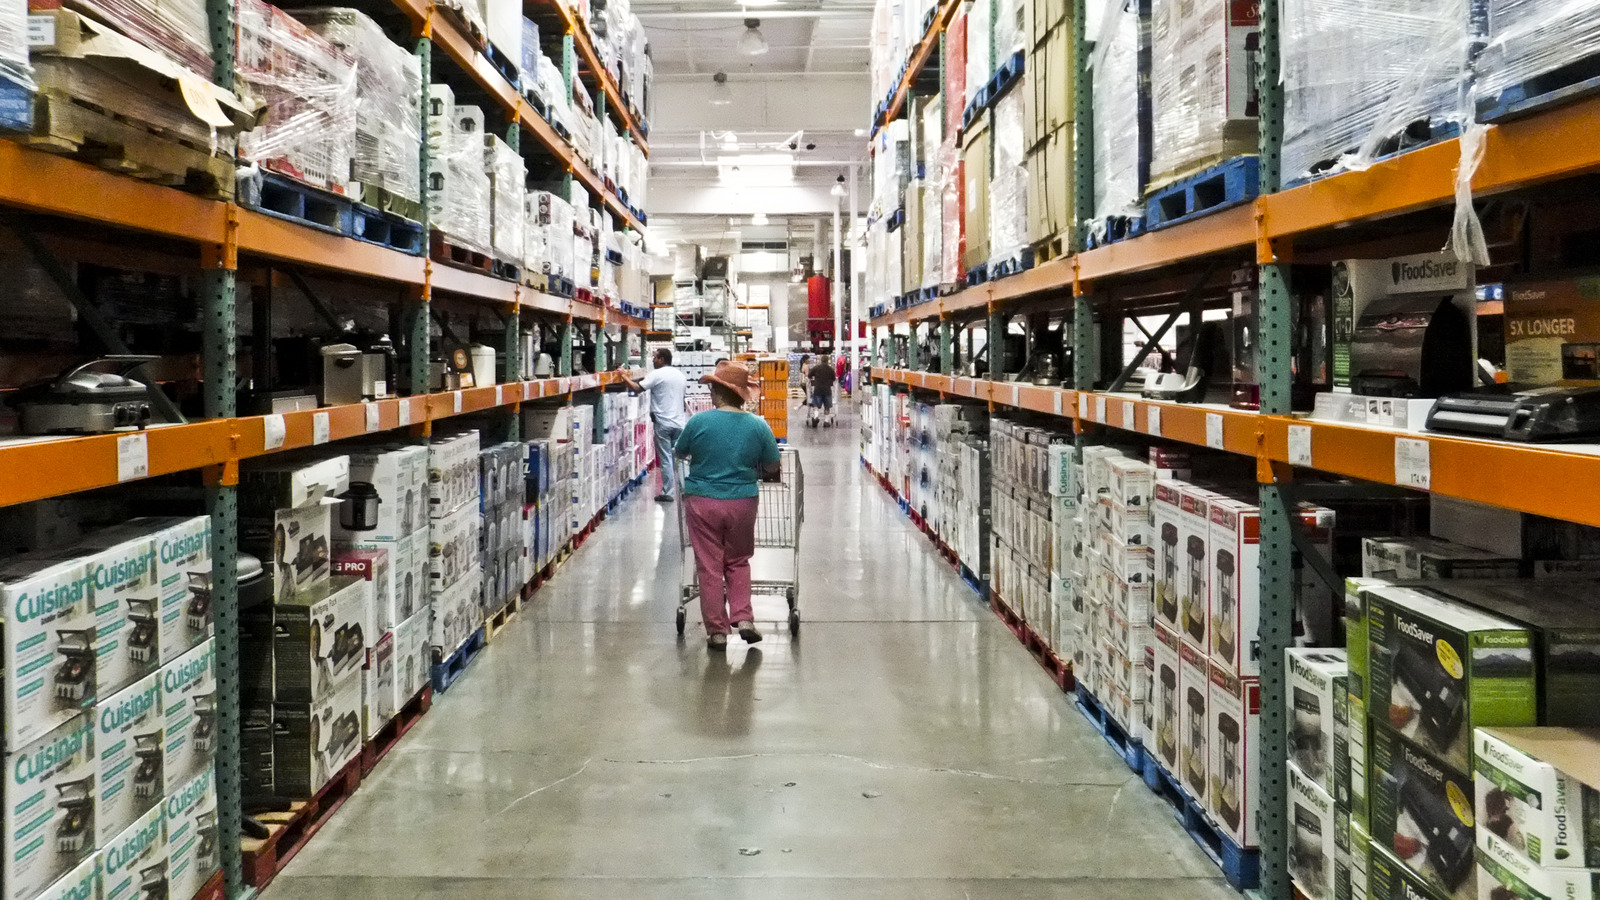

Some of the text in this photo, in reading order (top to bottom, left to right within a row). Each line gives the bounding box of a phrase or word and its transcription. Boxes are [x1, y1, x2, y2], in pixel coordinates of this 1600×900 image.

[1402, 260, 1457, 281] FoodSaver
[1512, 289, 1546, 300] FoodSaver
[1527, 318, 1575, 335] LONGER
[1059, 451, 1067, 494] Cuisinart
[160, 528, 211, 565] Cuisinart
[1372, 545, 1401, 563] FoodSaver
[94, 549, 157, 591] Cuisinart
[344, 562, 366, 571] PRO
[15, 570, 95, 623] Cuisinart
[1397, 617, 1434, 645] FoodSaver
[164, 648, 215, 694] Cuisinart
[1295, 659, 1327, 691] FoodSaver
[100, 682, 162, 734] Cuisinart
[14, 723, 94, 785] Cuisinart
[1405, 748, 1444, 782] FoodSaver
[1489, 745, 1524, 773] FoodSaver
[168, 764, 214, 820] Cuisinart
[1296, 773, 1329, 814] FoodSaver
[1555, 777, 1567, 846] FoodSaver
[106, 809, 167, 875] Cuisinart
[1493, 842, 1531, 874] FoodSaver
